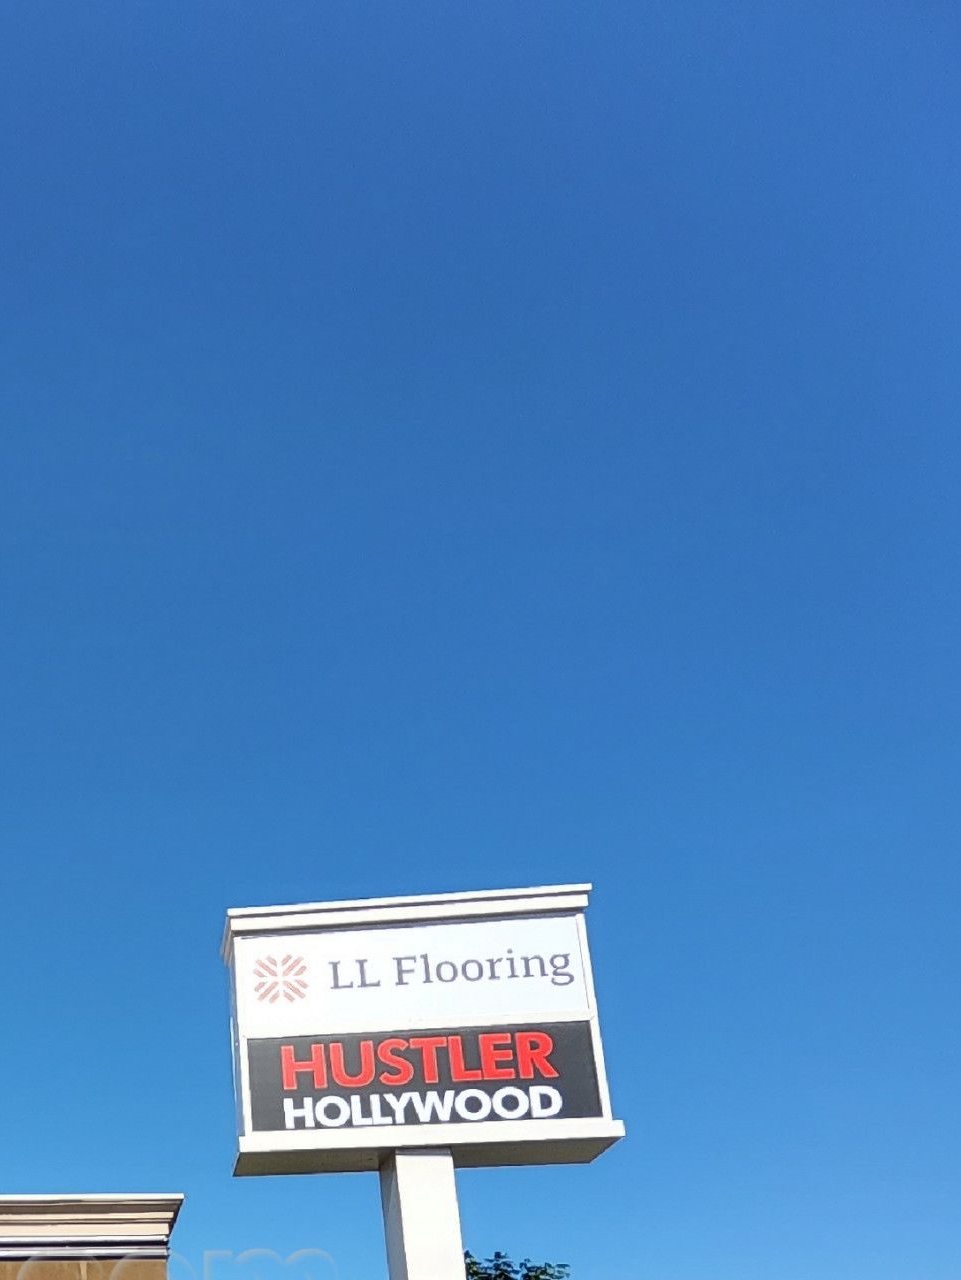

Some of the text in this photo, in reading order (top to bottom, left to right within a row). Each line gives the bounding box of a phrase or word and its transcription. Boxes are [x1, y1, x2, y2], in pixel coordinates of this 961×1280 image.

[328, 948, 575, 990] LL Flooring
[280, 1031, 560, 1090] HUSTLER
[283, 1085, 563, 1129] HOLLYWOOD
